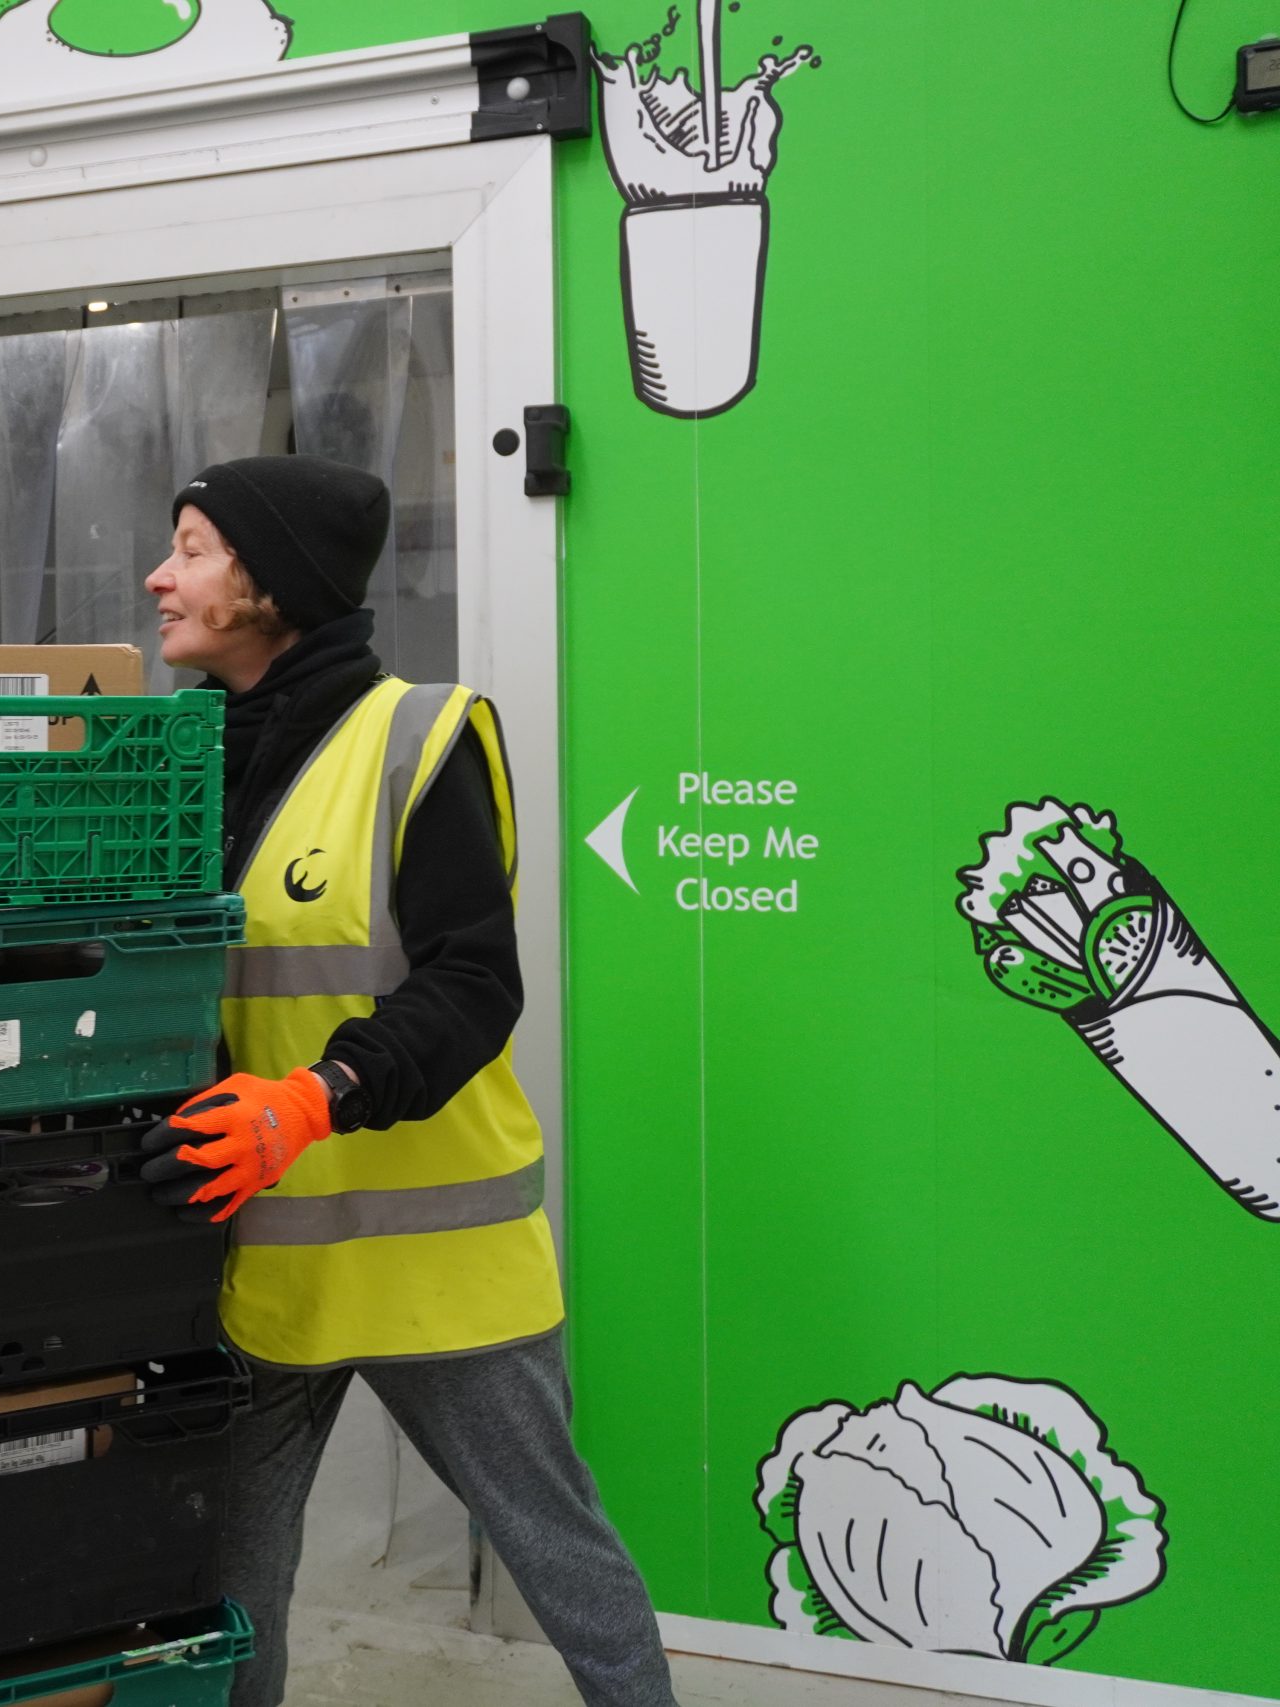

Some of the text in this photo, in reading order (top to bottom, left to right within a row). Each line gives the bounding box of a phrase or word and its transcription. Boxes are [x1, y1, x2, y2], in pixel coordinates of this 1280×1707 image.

[680, 772, 797, 804] Please
[659, 826, 818, 865] Keep Me
[676, 878, 797, 912] Closed
